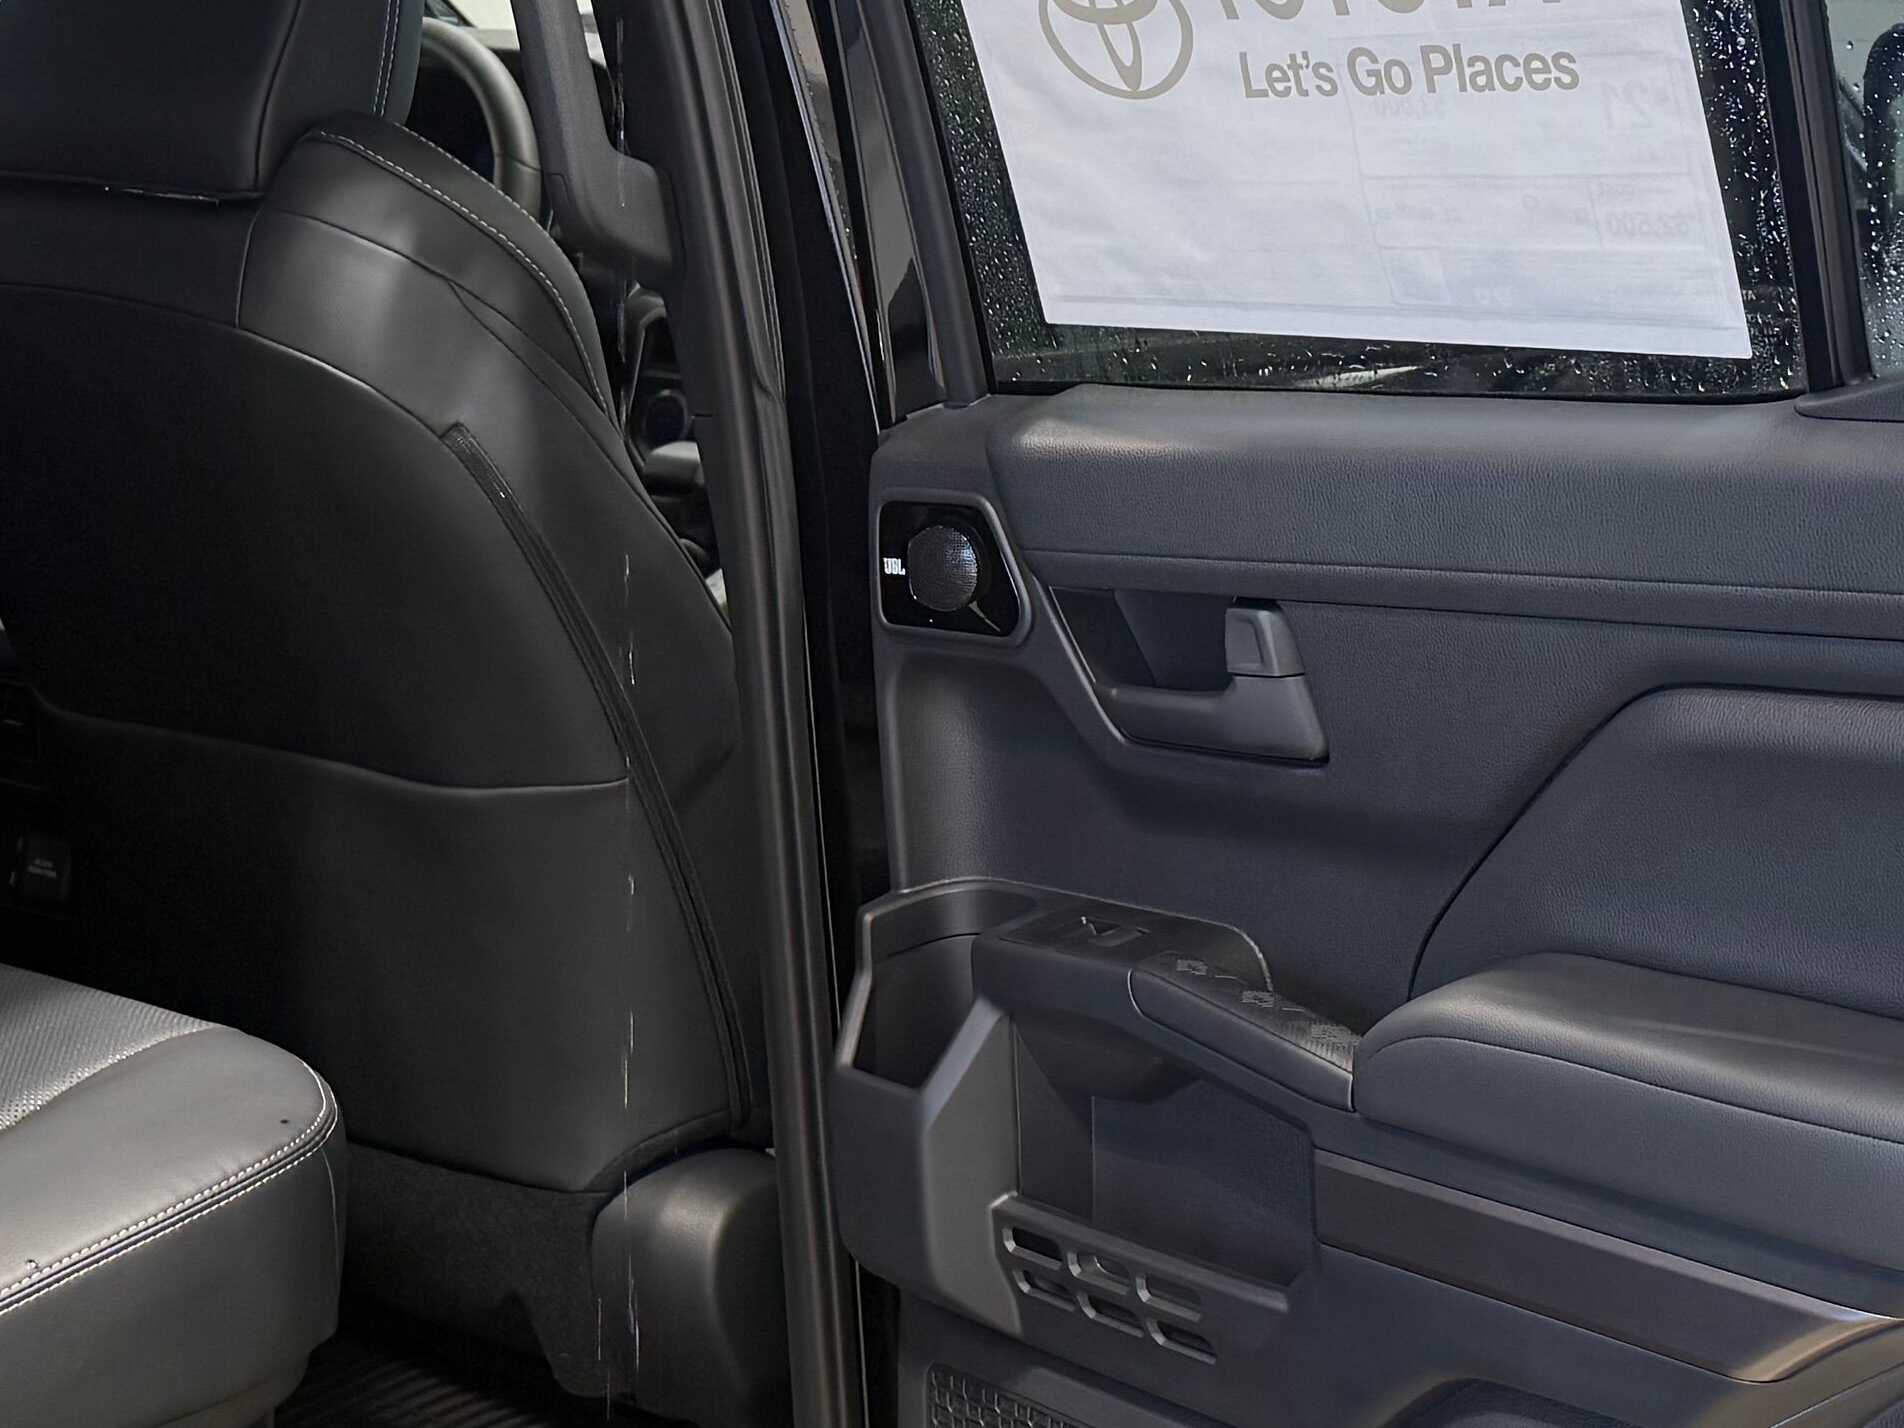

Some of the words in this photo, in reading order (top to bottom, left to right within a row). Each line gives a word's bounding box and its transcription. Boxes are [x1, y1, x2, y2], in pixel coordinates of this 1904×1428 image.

[1239, 49, 1335, 99] Let's
[1346, 46, 1413, 97] Go
[1419, 43, 1581, 95] Places
